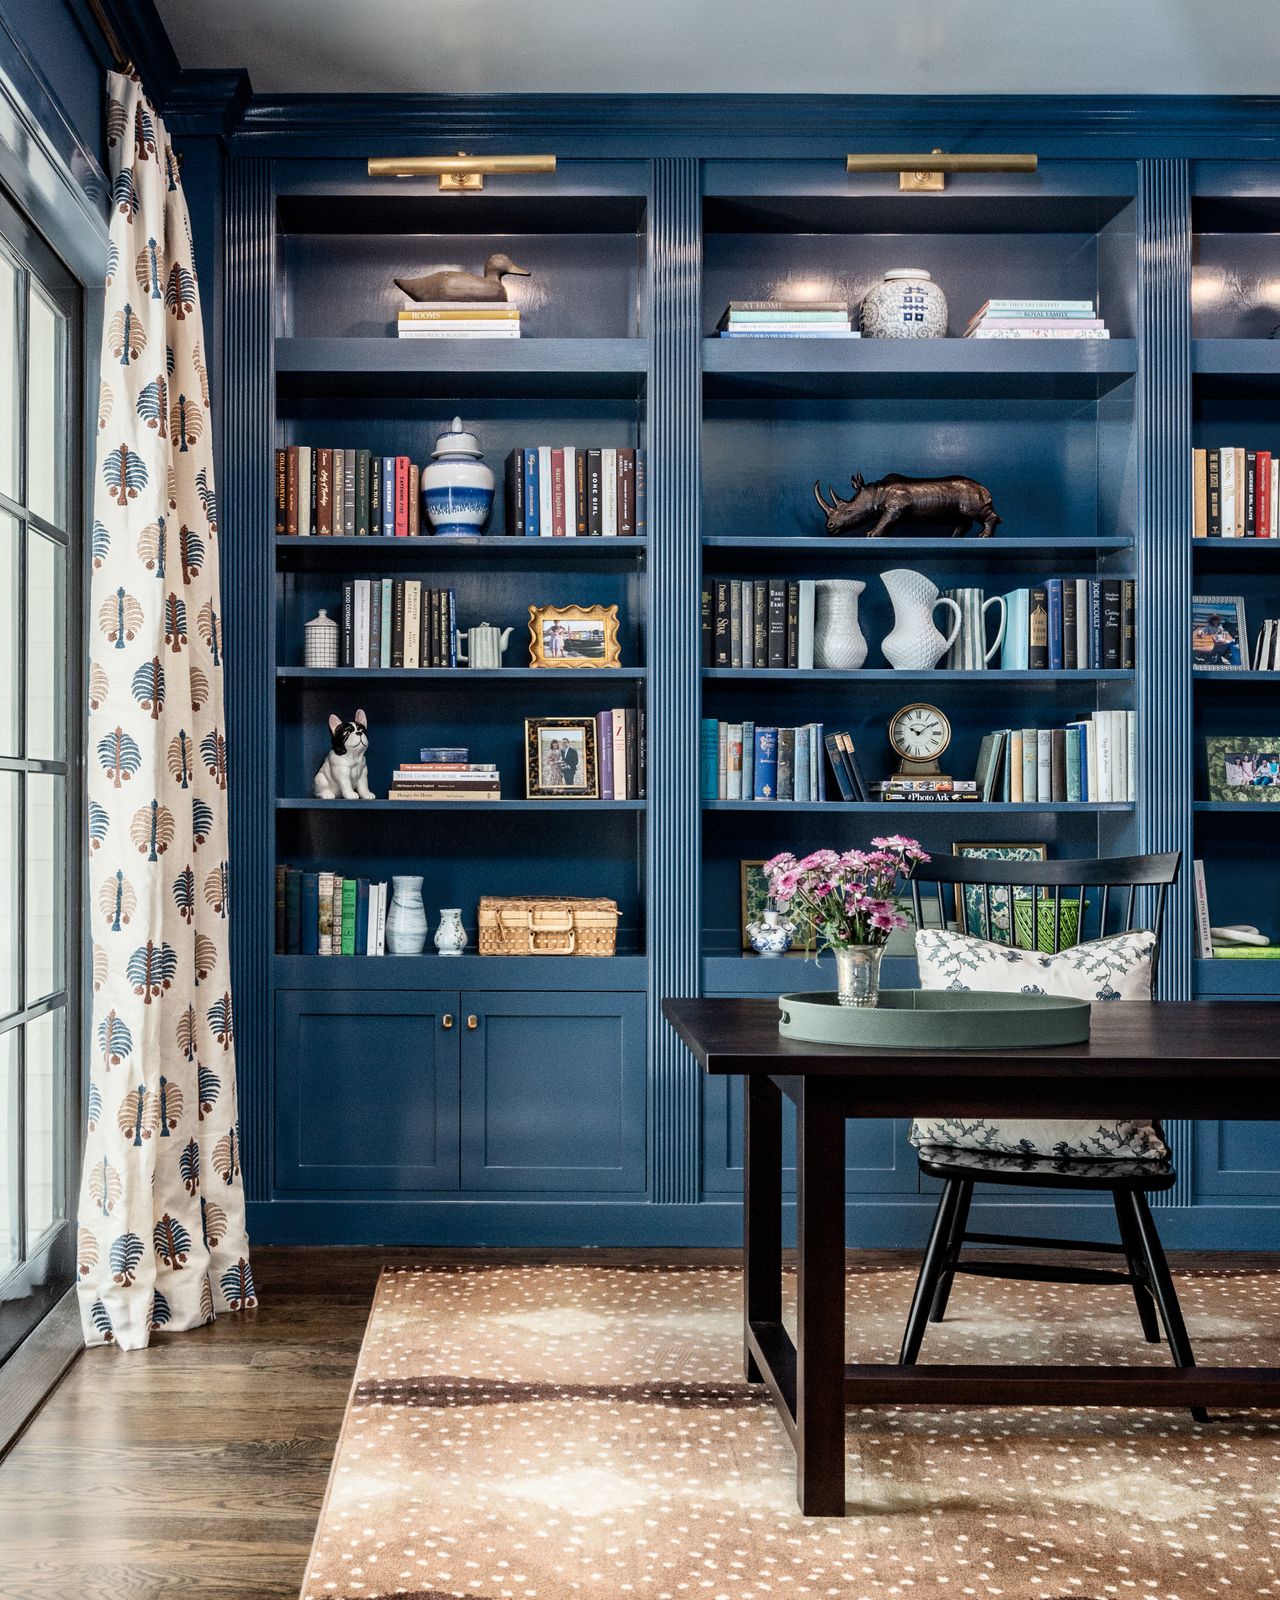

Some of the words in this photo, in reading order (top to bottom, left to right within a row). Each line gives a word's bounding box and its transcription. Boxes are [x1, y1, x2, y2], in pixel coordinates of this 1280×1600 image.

[411, 312, 441, 320] ROOMS
[335, 466, 343, 485] Walked
[555, 492, 563, 518] Elephants
[718, 584, 727, 601] DANIELLE
[718, 600, 727, 613] STEEL
[1104, 608, 1120, 616] Cutting
[716, 617, 729, 636] STAR
[911, 793, 935, 801] Photo
[935, 793, 950, 801] Ark
